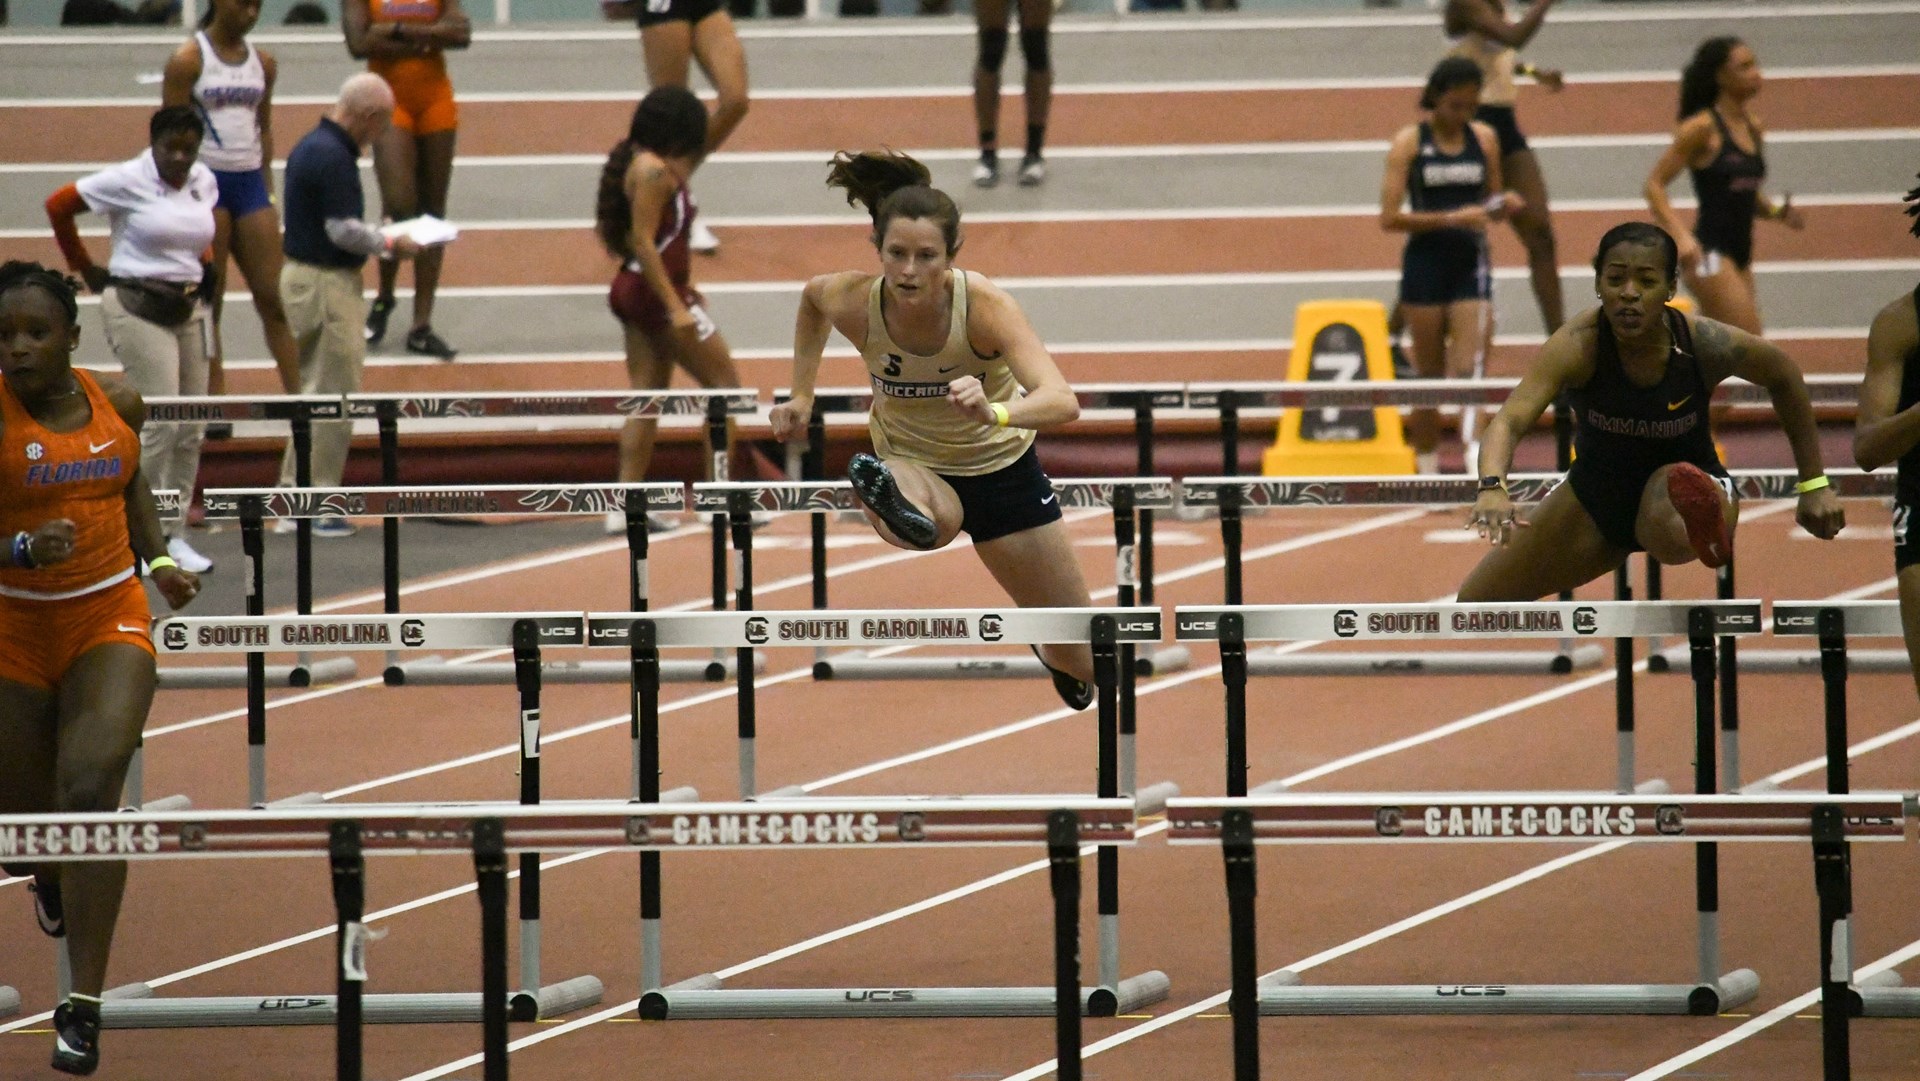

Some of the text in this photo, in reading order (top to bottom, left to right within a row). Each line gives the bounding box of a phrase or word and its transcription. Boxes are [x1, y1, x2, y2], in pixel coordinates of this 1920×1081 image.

[873, 376, 949, 398] BUCCANE
[311, 406, 337, 414] UCS
[25, 456, 122, 487] FLORIDA
[386, 499, 499, 513] GAMECOCKS
[1180, 621, 1216, 631] UCS
[1367, 611, 1564, 634] SOUTH CAROLINA
[1717, 615, 1754, 625] UCS
[1777, 616, 1815, 626] UCS
[540, 627, 576, 636] UCS
[593, 628, 629, 638] UCS
[778, 618, 970, 641] SOUTH CAROLINA
[1118, 622, 1154, 632] UCS
[198, 622, 392, 646] SOUTH CAROLINA
[1424, 805, 1636, 836] GAMECOCKS
[672, 812, 880, 845] GAMECOCKS
[0, 823, 160, 856] MECOCKS
[845, 990, 914, 1002] UCS
[1437, 985, 1506, 997] UCS
